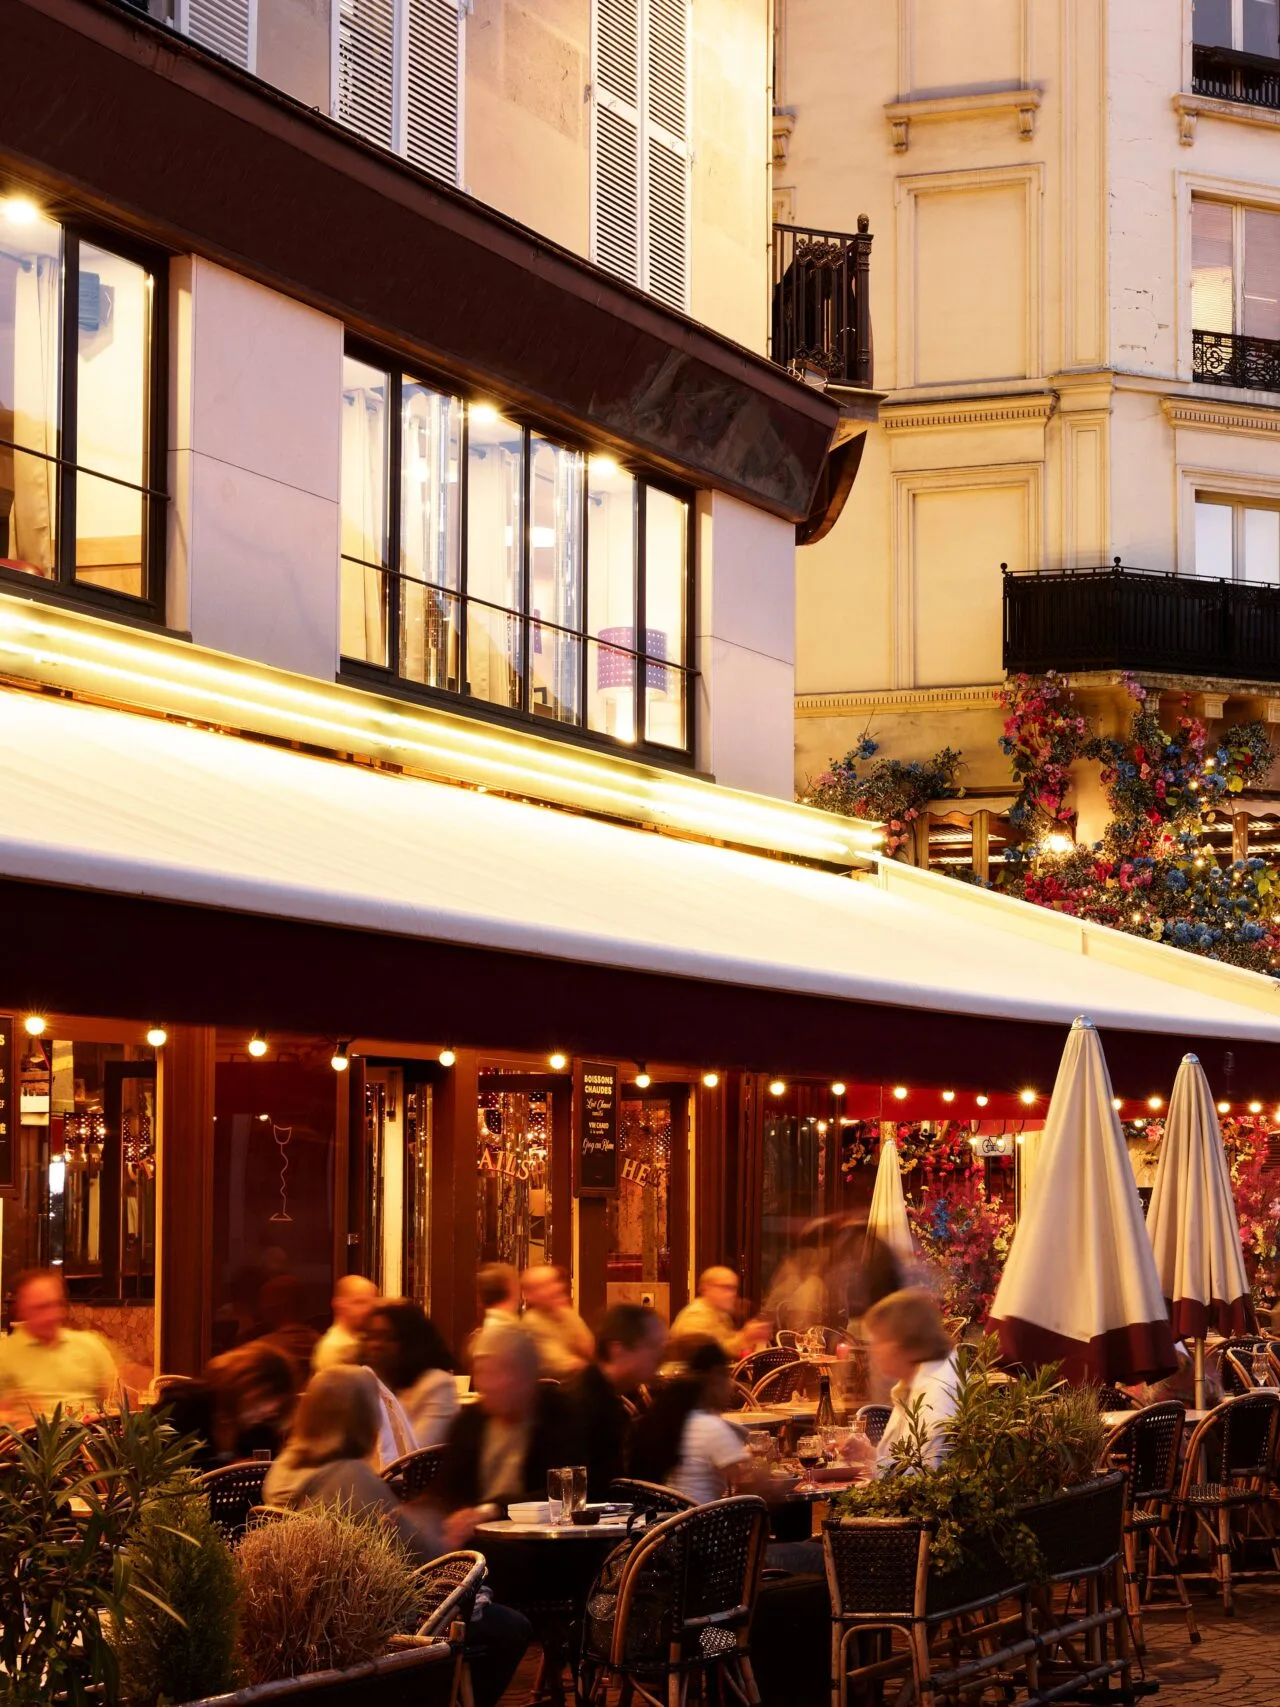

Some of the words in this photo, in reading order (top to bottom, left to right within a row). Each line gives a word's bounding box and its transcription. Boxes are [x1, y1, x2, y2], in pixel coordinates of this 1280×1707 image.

[584, 1075, 613, 1085] BOISSONS
[584, 1085, 612, 1095] CHAUDES
[477, 1147, 530, 1180] AILS
